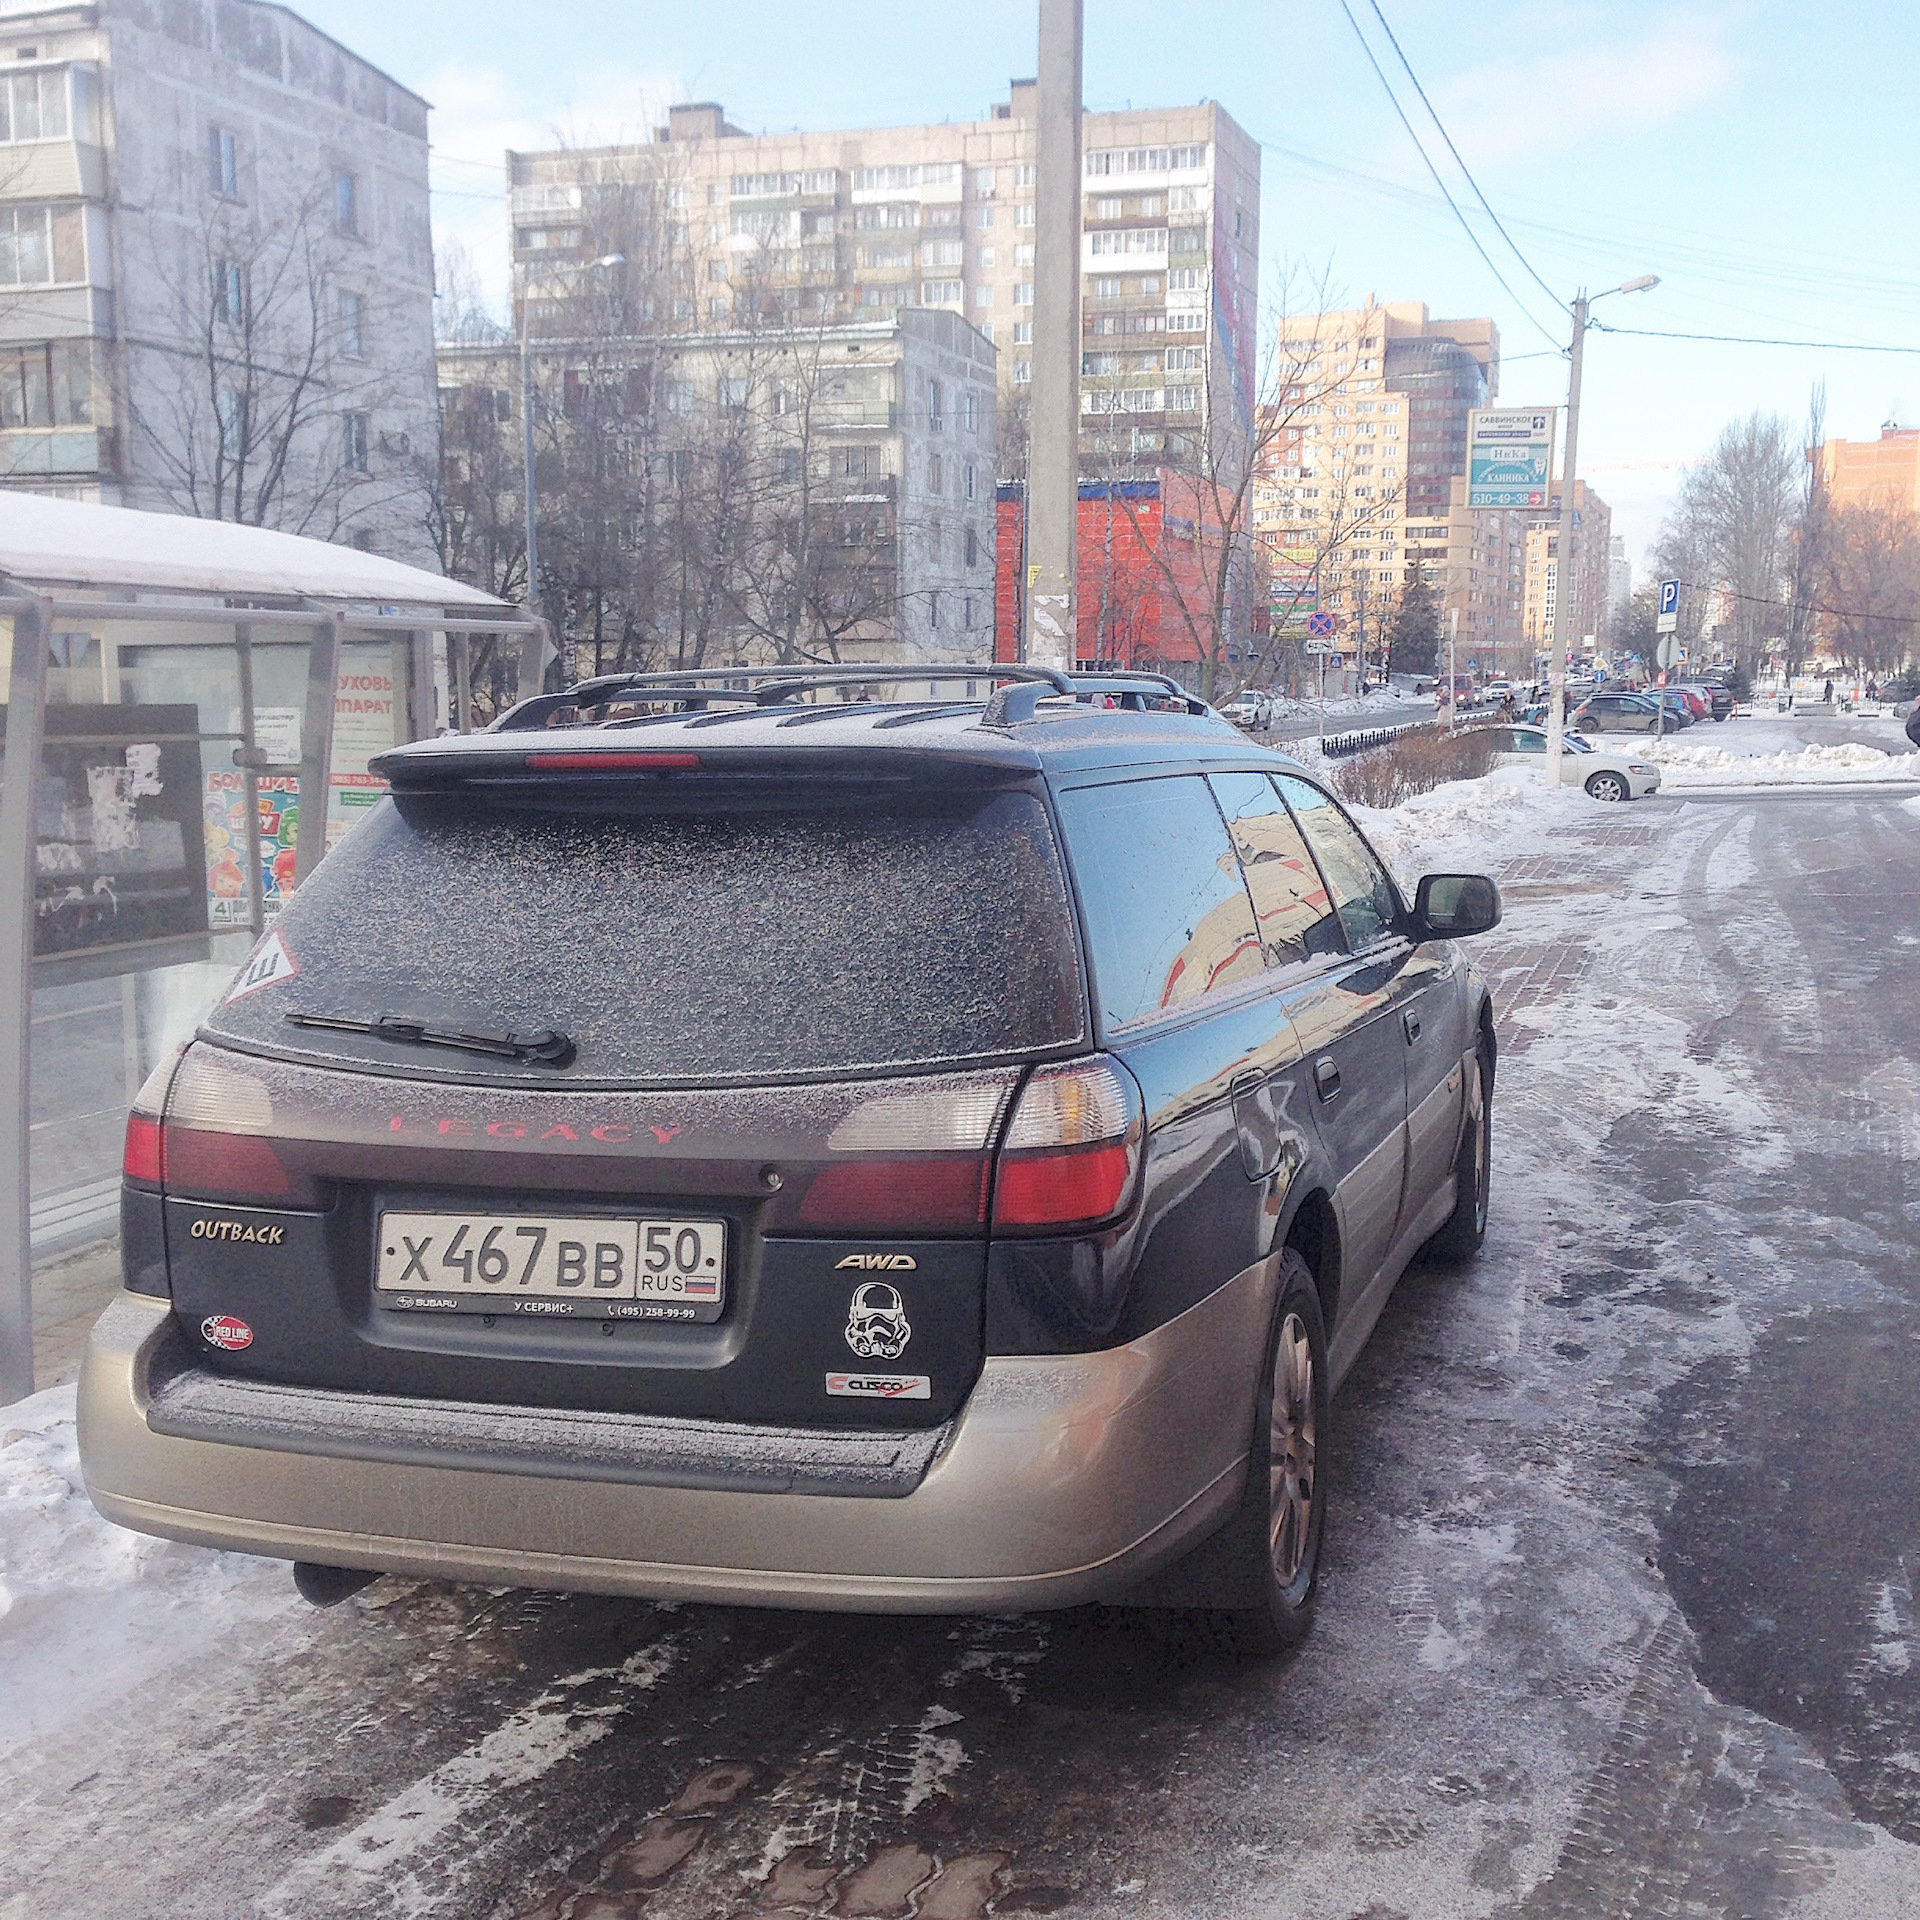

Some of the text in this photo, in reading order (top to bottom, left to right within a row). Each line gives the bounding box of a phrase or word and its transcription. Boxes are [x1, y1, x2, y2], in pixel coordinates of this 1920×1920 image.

[1487, 473, 1530, 483] КЛИНИКА
[1472, 493, 1529, 504] 510-49-38
[1663, 584, 1675, 611] P
[208, 772, 299, 794] БОЛШИЕ
[389, 1115, 684, 1145] LEGACY
[190, 1219, 284, 1245] OUTBACK
[645, 1227, 701, 1274] 50
[834, 1254, 918, 1270] AWD
[641, 1275, 683, 1292] RUS
[415, 1298, 458, 1309] SUBARU
[617, 1306, 696, 1319] (495) 258-99-99
[215, 1326, 231, 1338] RED
[232, 1327, 250, 1340] LINE
[848, 1380, 903, 1391] CUSCO
